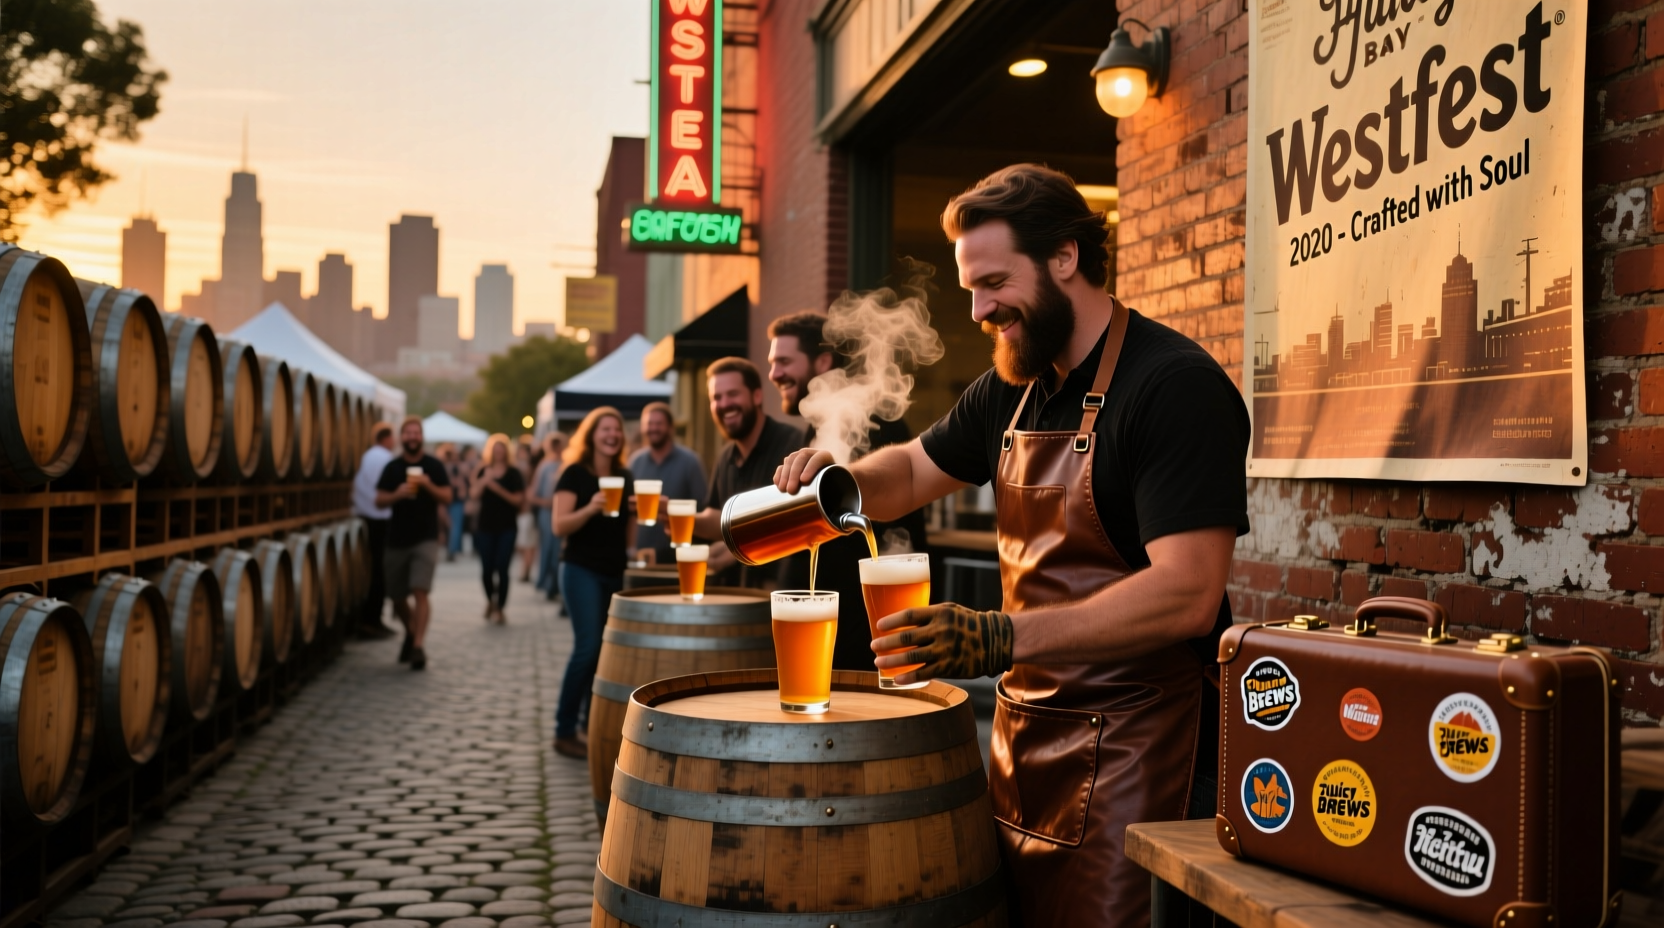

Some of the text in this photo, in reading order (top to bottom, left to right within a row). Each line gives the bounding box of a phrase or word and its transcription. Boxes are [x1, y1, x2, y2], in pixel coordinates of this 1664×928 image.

[1364, 22, 1411, 68] BAY
[1266, 1, 1551, 226] Westfest
[1290, 222, 1333, 267] 2020
[1351, 184, 1420, 242] Crafted
[1425, 165, 1473, 212] with
[1479, 137, 1530, 191] Soul
